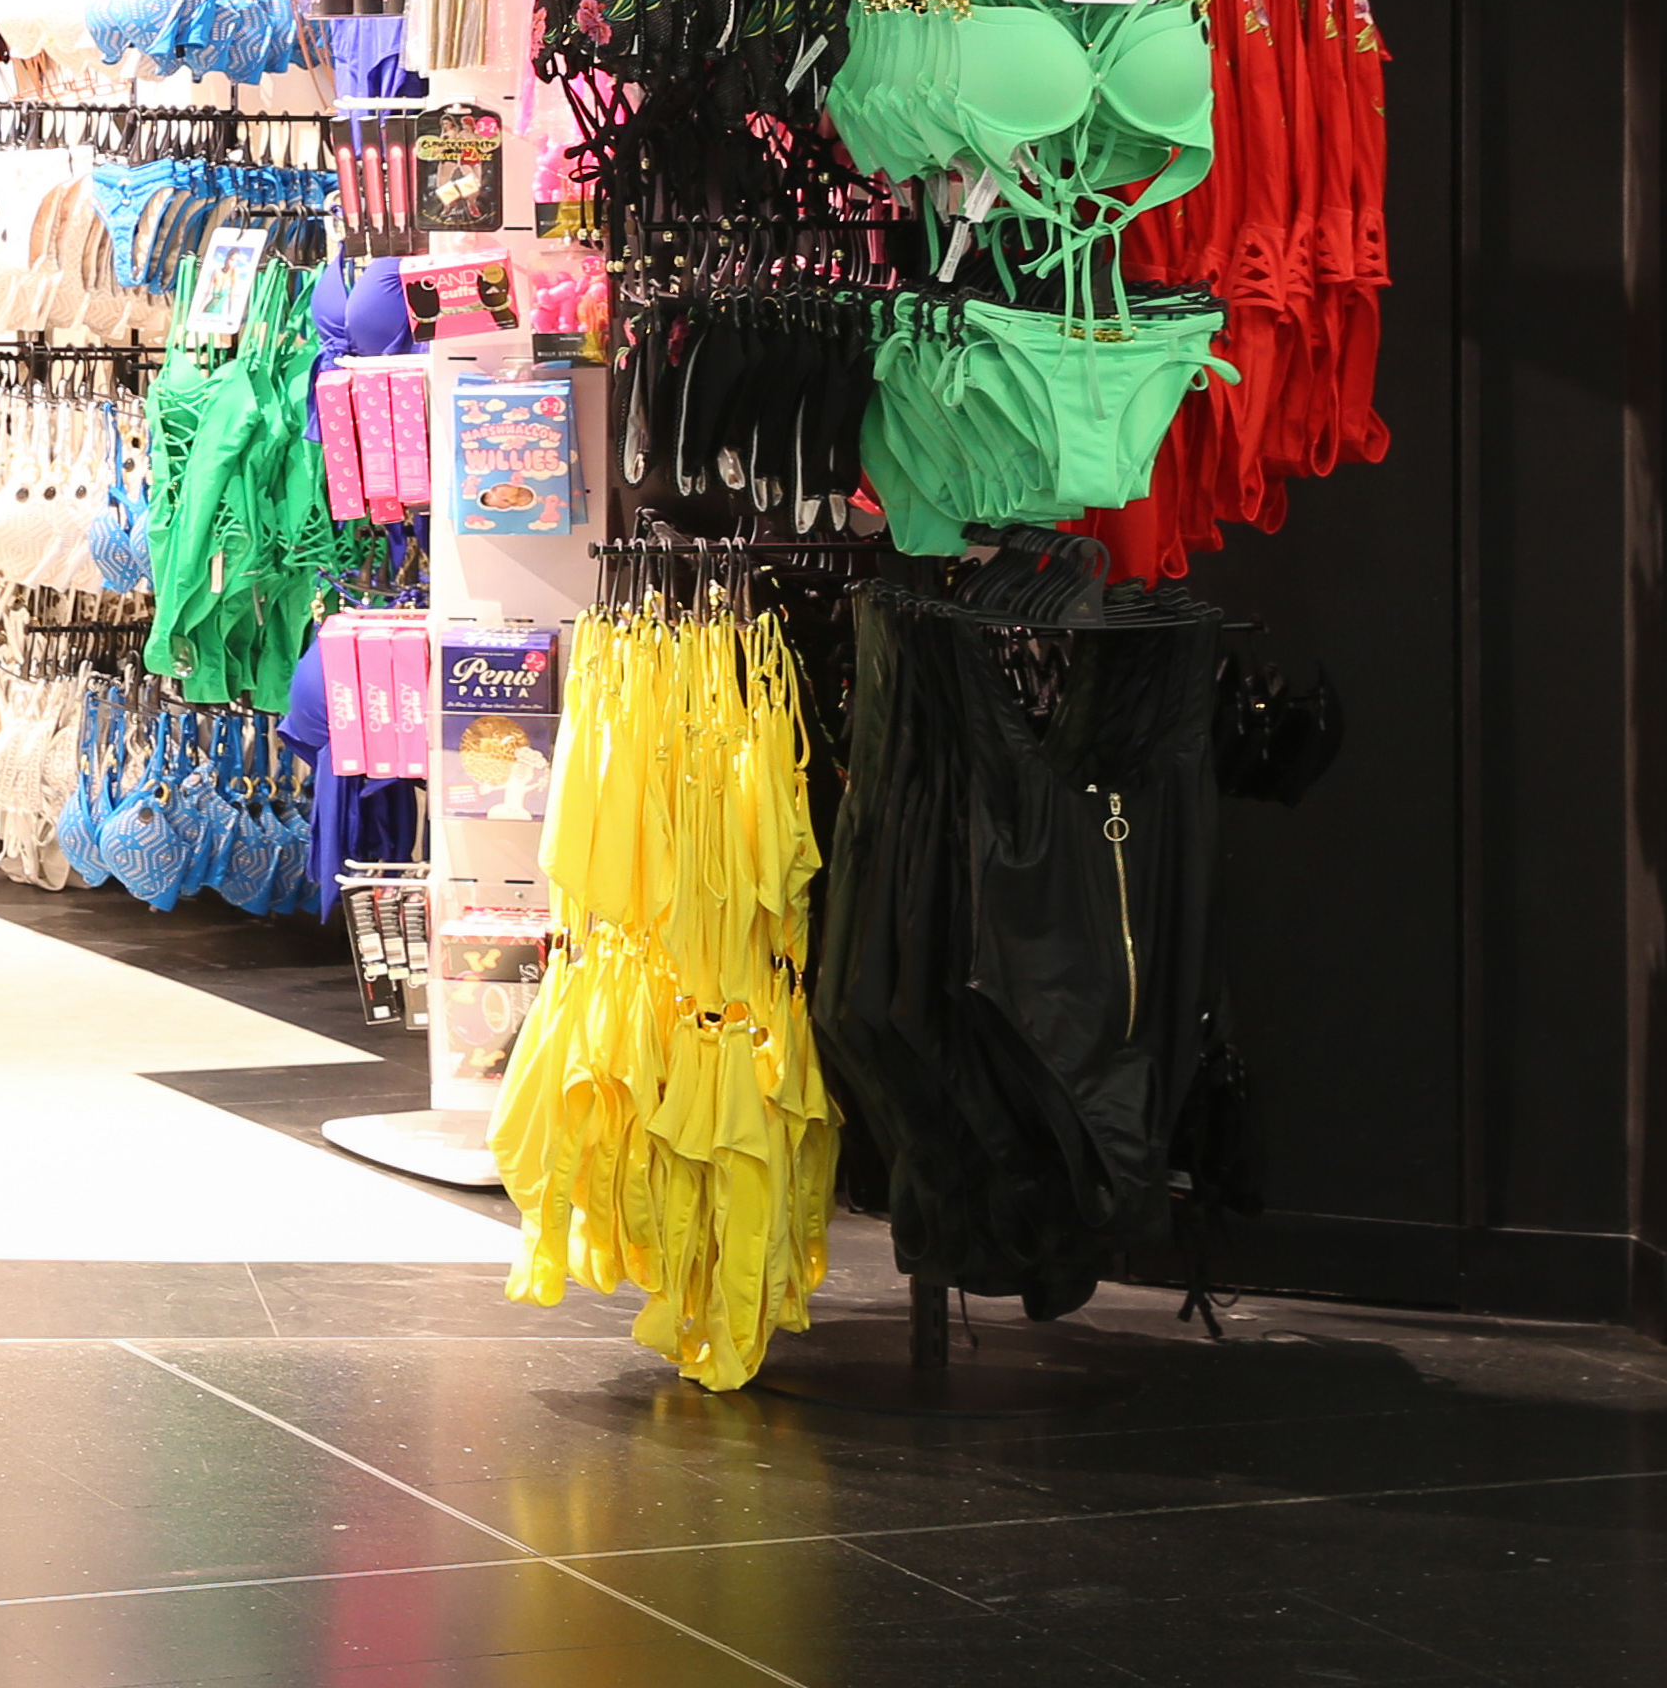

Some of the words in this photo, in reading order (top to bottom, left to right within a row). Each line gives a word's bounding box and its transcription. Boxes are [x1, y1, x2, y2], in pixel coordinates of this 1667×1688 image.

[420, 268, 486, 291] CANDY
[439, 285, 478, 300] cuffs
[460, 422, 563, 443] MARSHMALLOW
[464, 448, 560, 472] WILLIES
[448, 656, 540, 686] Penis
[457, 685, 529, 698] PASTA
[331, 679, 348, 730] CANDY
[366, 681, 382, 733] CANDY
[399, 682, 415, 733] CANDY
